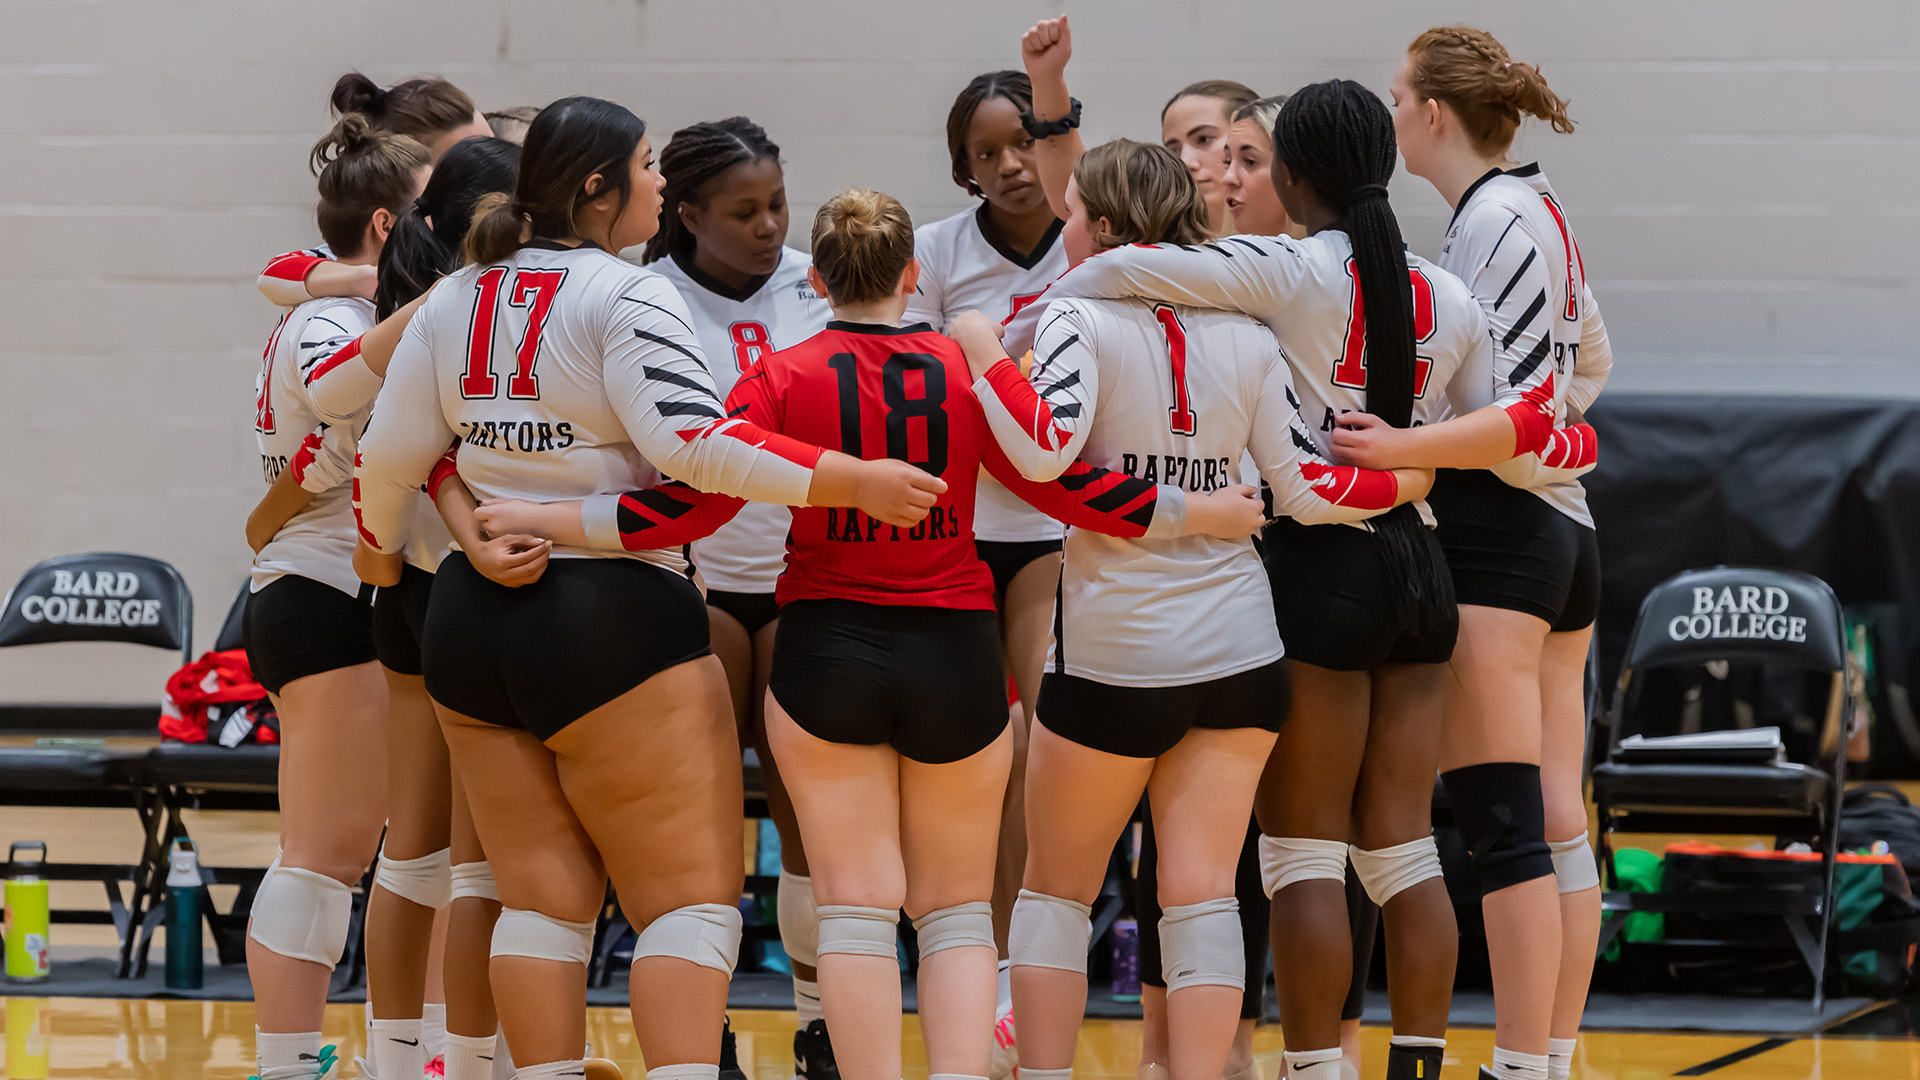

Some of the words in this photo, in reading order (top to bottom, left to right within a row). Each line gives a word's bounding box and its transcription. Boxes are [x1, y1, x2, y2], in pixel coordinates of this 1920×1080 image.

[460, 266, 569, 401] 17
[728, 320, 776, 375] 8
[1152, 302, 1197, 437] 1
[828, 352, 948, 478] 18
[1122, 453, 1229, 492] RAPTORS
[52, 570, 139, 598] BARD
[1692, 586, 1789, 615] BARD
[21, 595, 161, 627] COLLEGE
[1668, 614, 1807, 643] COLLEGE
